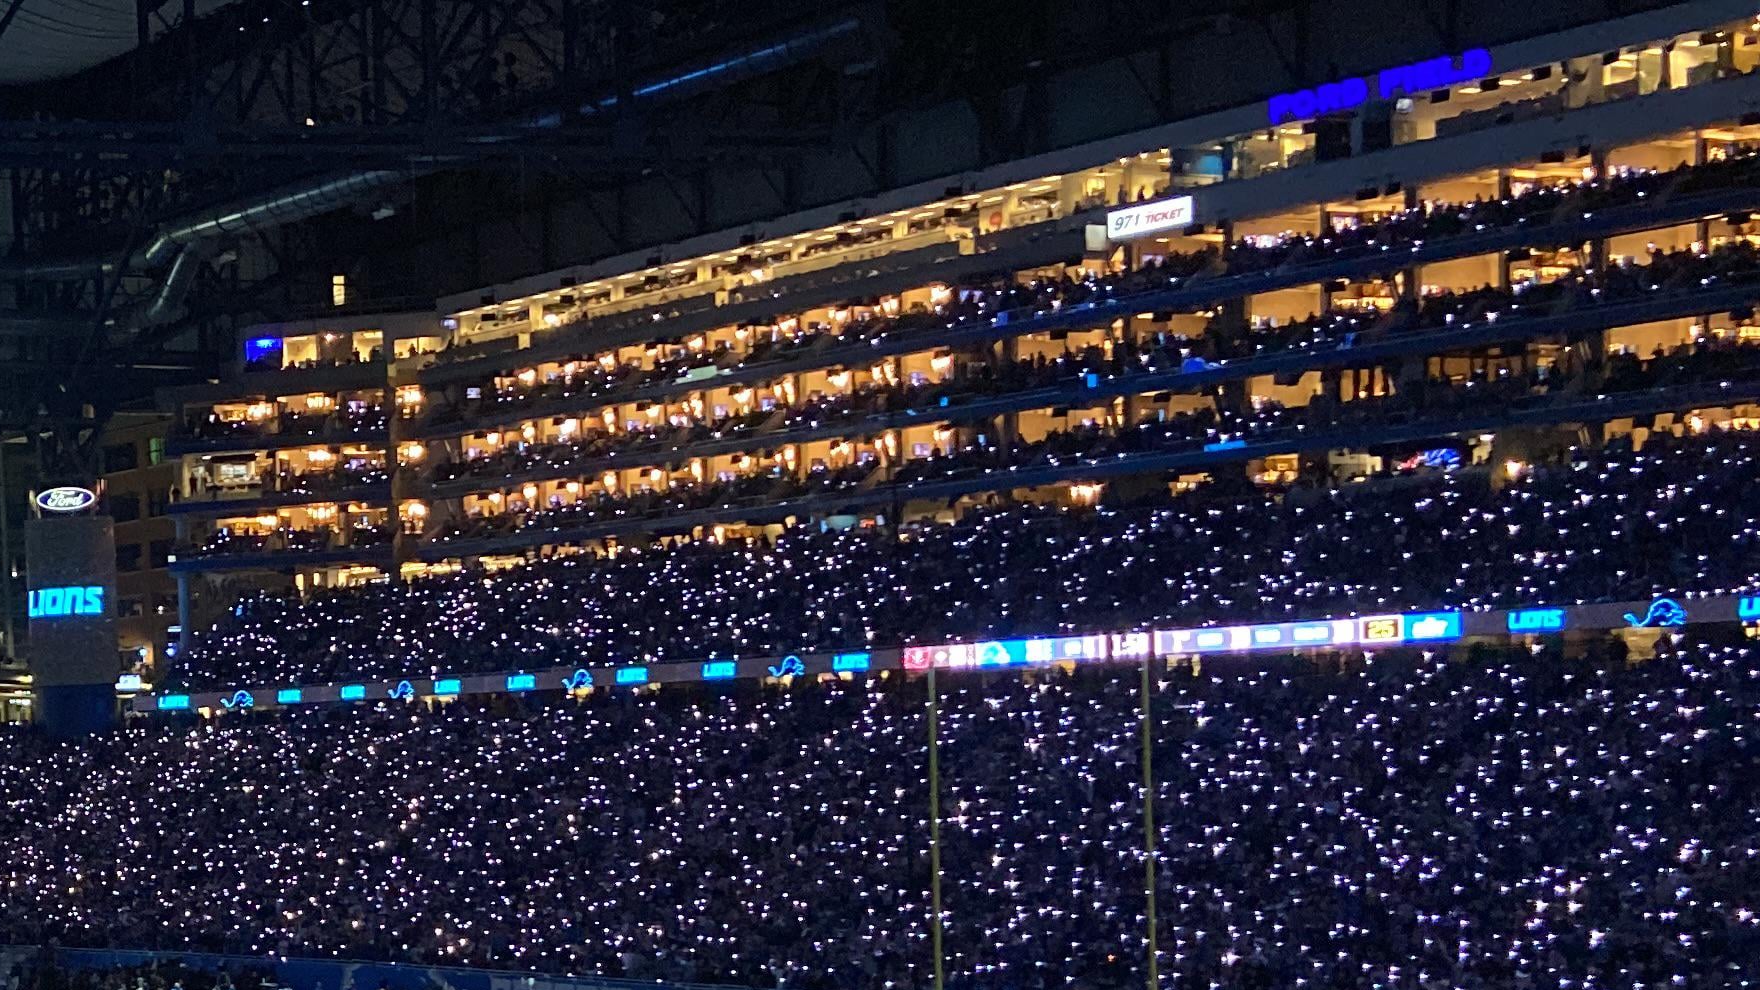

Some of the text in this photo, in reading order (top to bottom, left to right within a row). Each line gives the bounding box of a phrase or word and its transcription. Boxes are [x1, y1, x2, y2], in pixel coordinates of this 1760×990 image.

[1114, 208, 1184, 231] 971 TICKET
[47, 489, 84, 507] Ford
[28, 586, 104, 618] LIONS
